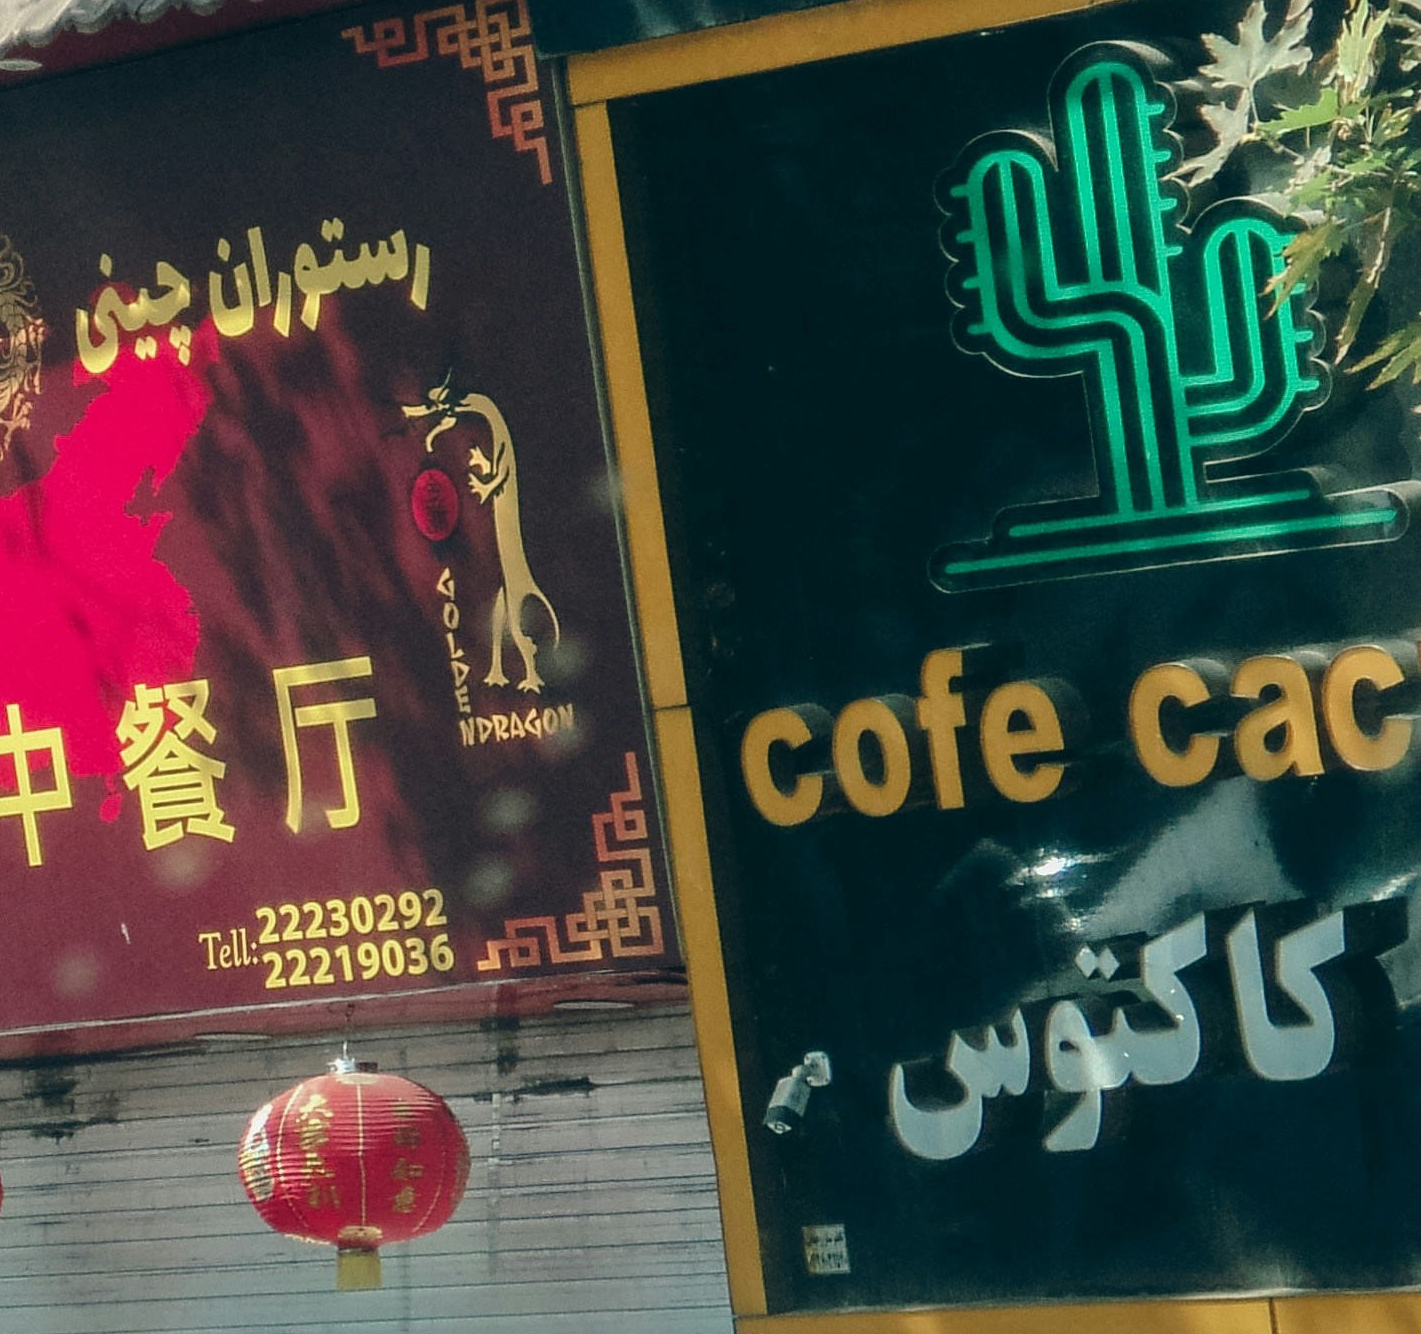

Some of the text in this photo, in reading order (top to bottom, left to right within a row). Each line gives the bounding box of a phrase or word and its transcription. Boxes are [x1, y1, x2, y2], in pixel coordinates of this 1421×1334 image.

[76, 253, 191, 373] چینی
[209, 217, 431, 337] رستوران
[740, 640, 1421, 827] cofe cac
[198, 888, 448, 970] Tell: 22230292
[261, 933, 455, 989] 22219036
[889, 908, 1347, 1161] کاکتوس
